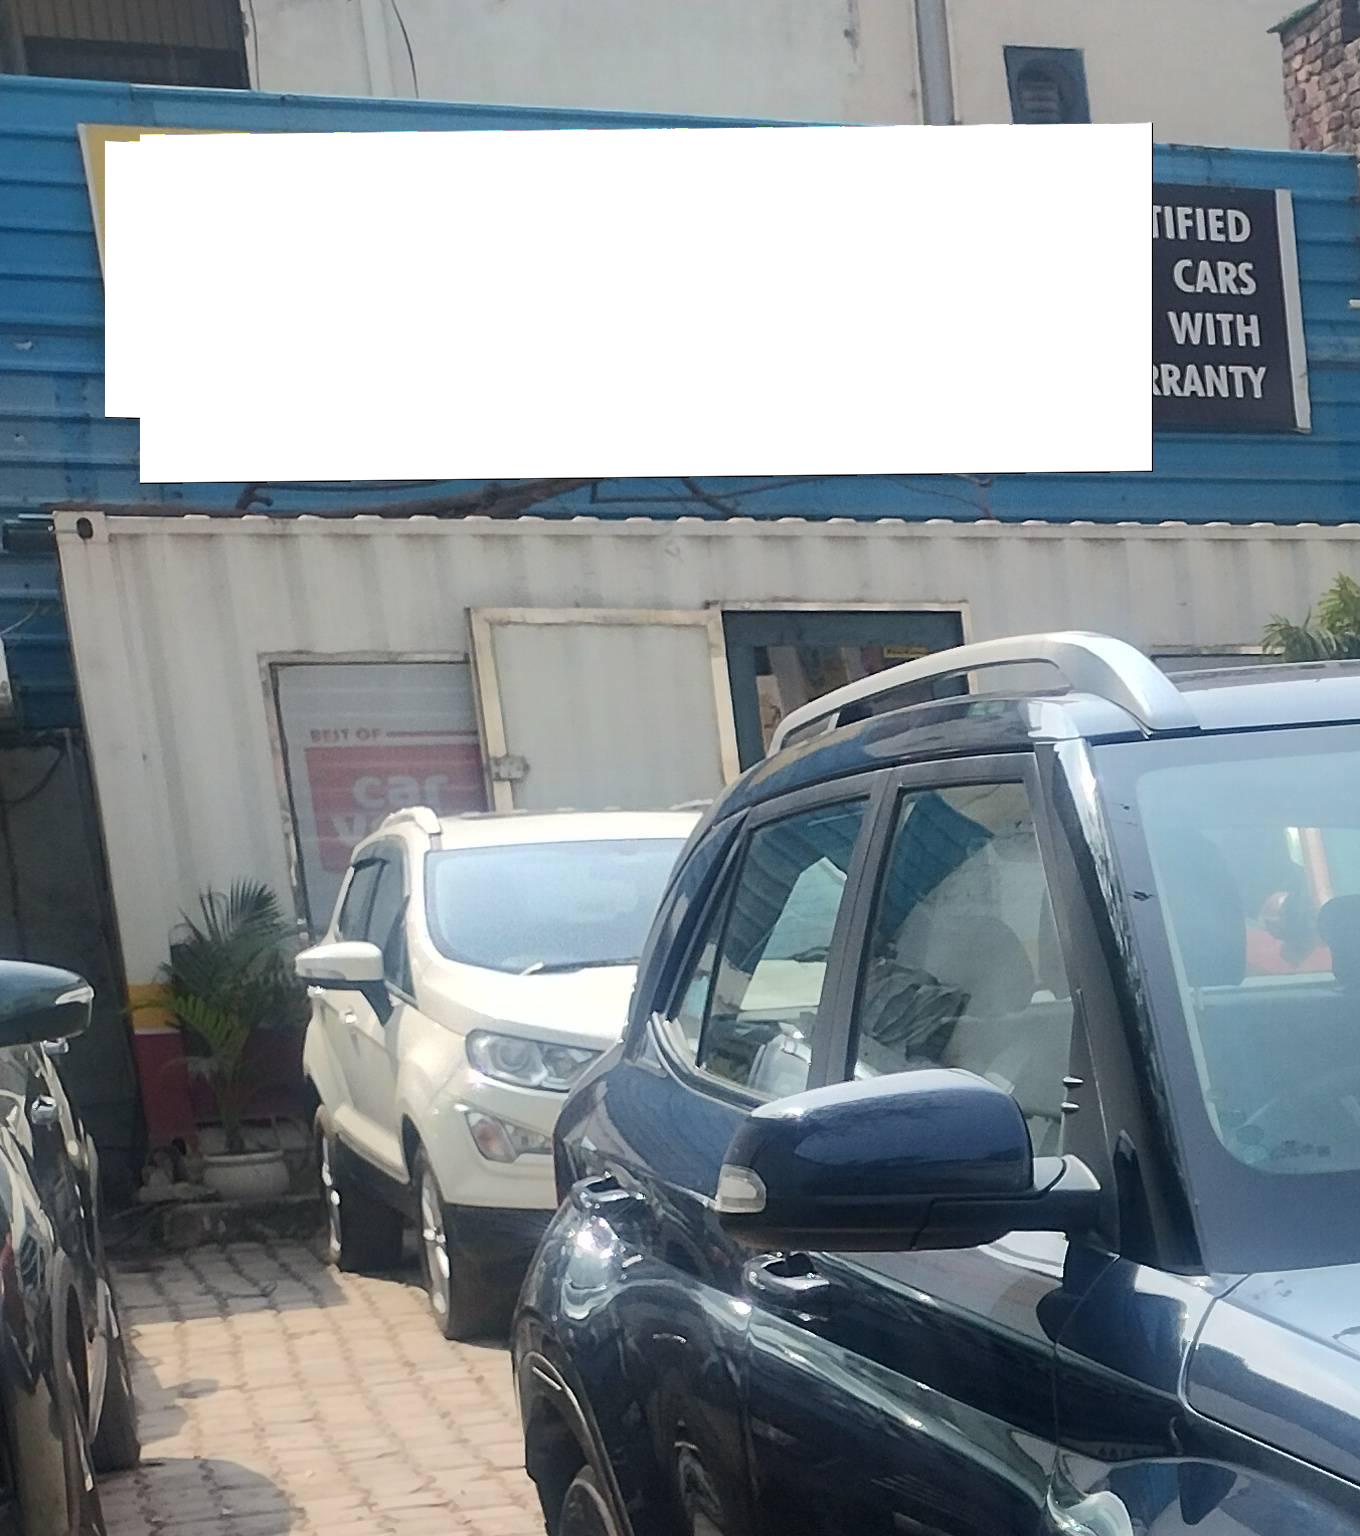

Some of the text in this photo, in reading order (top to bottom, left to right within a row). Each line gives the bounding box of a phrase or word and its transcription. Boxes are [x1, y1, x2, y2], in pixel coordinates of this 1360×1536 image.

[1173, 259, 1257, 295] CARS
[1167, 311, 1261, 347] WITH
[309, 727, 382, 742] BEST OF
